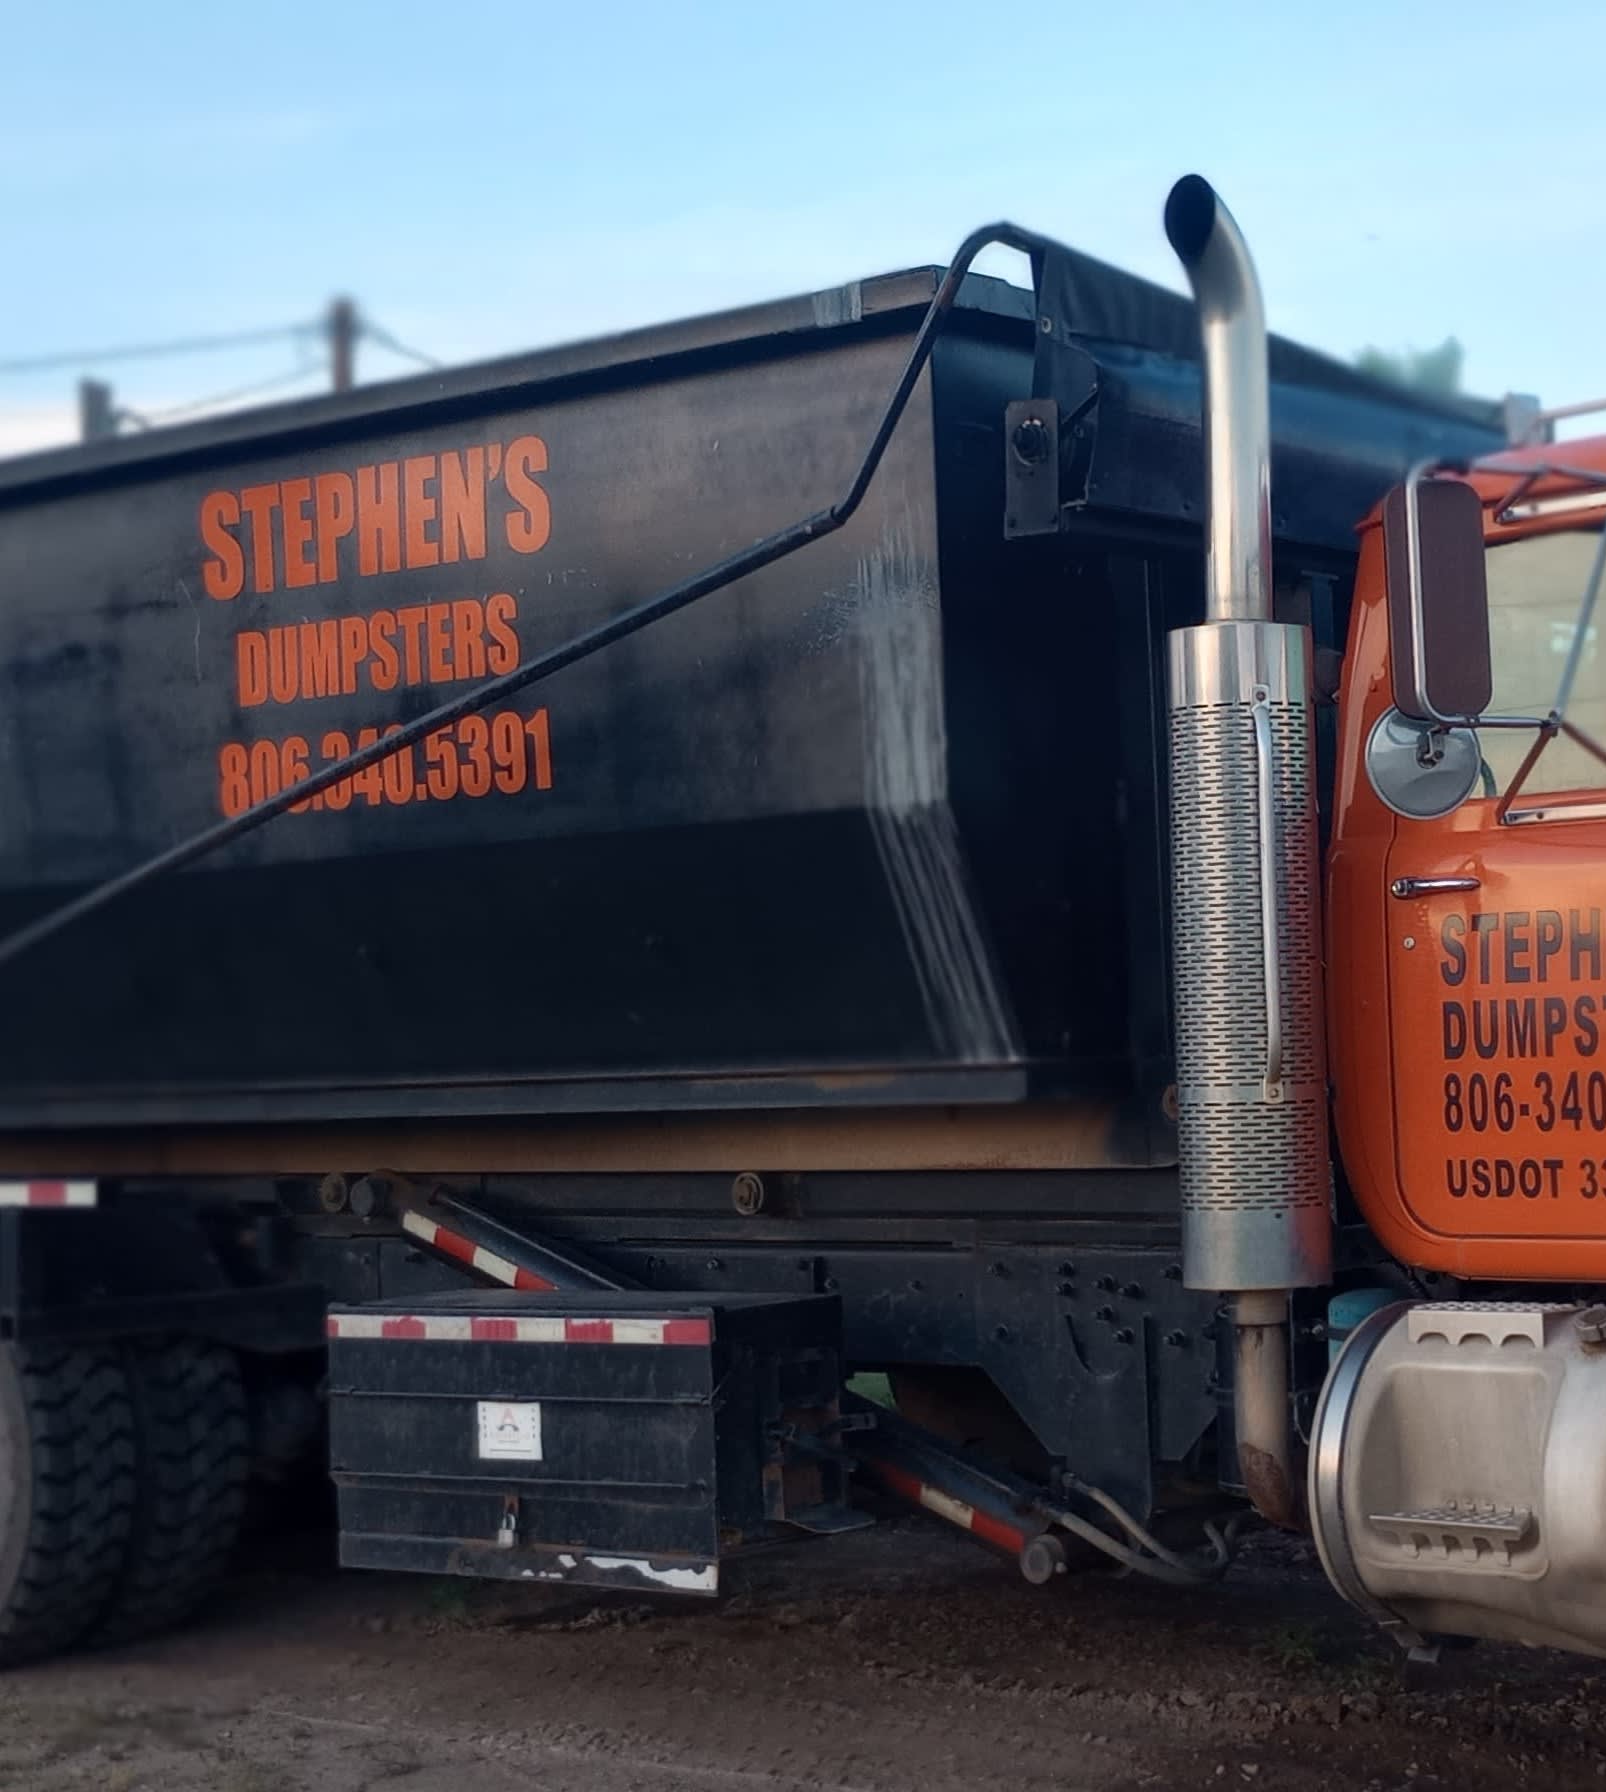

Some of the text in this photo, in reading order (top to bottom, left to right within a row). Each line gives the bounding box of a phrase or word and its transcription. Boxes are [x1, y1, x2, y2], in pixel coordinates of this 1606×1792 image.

[200, 436, 551, 600] STEPHEN'S
[237, 593, 520, 707] DUMPSTERS
[1446, 1158, 1563, 1199] USDOT
